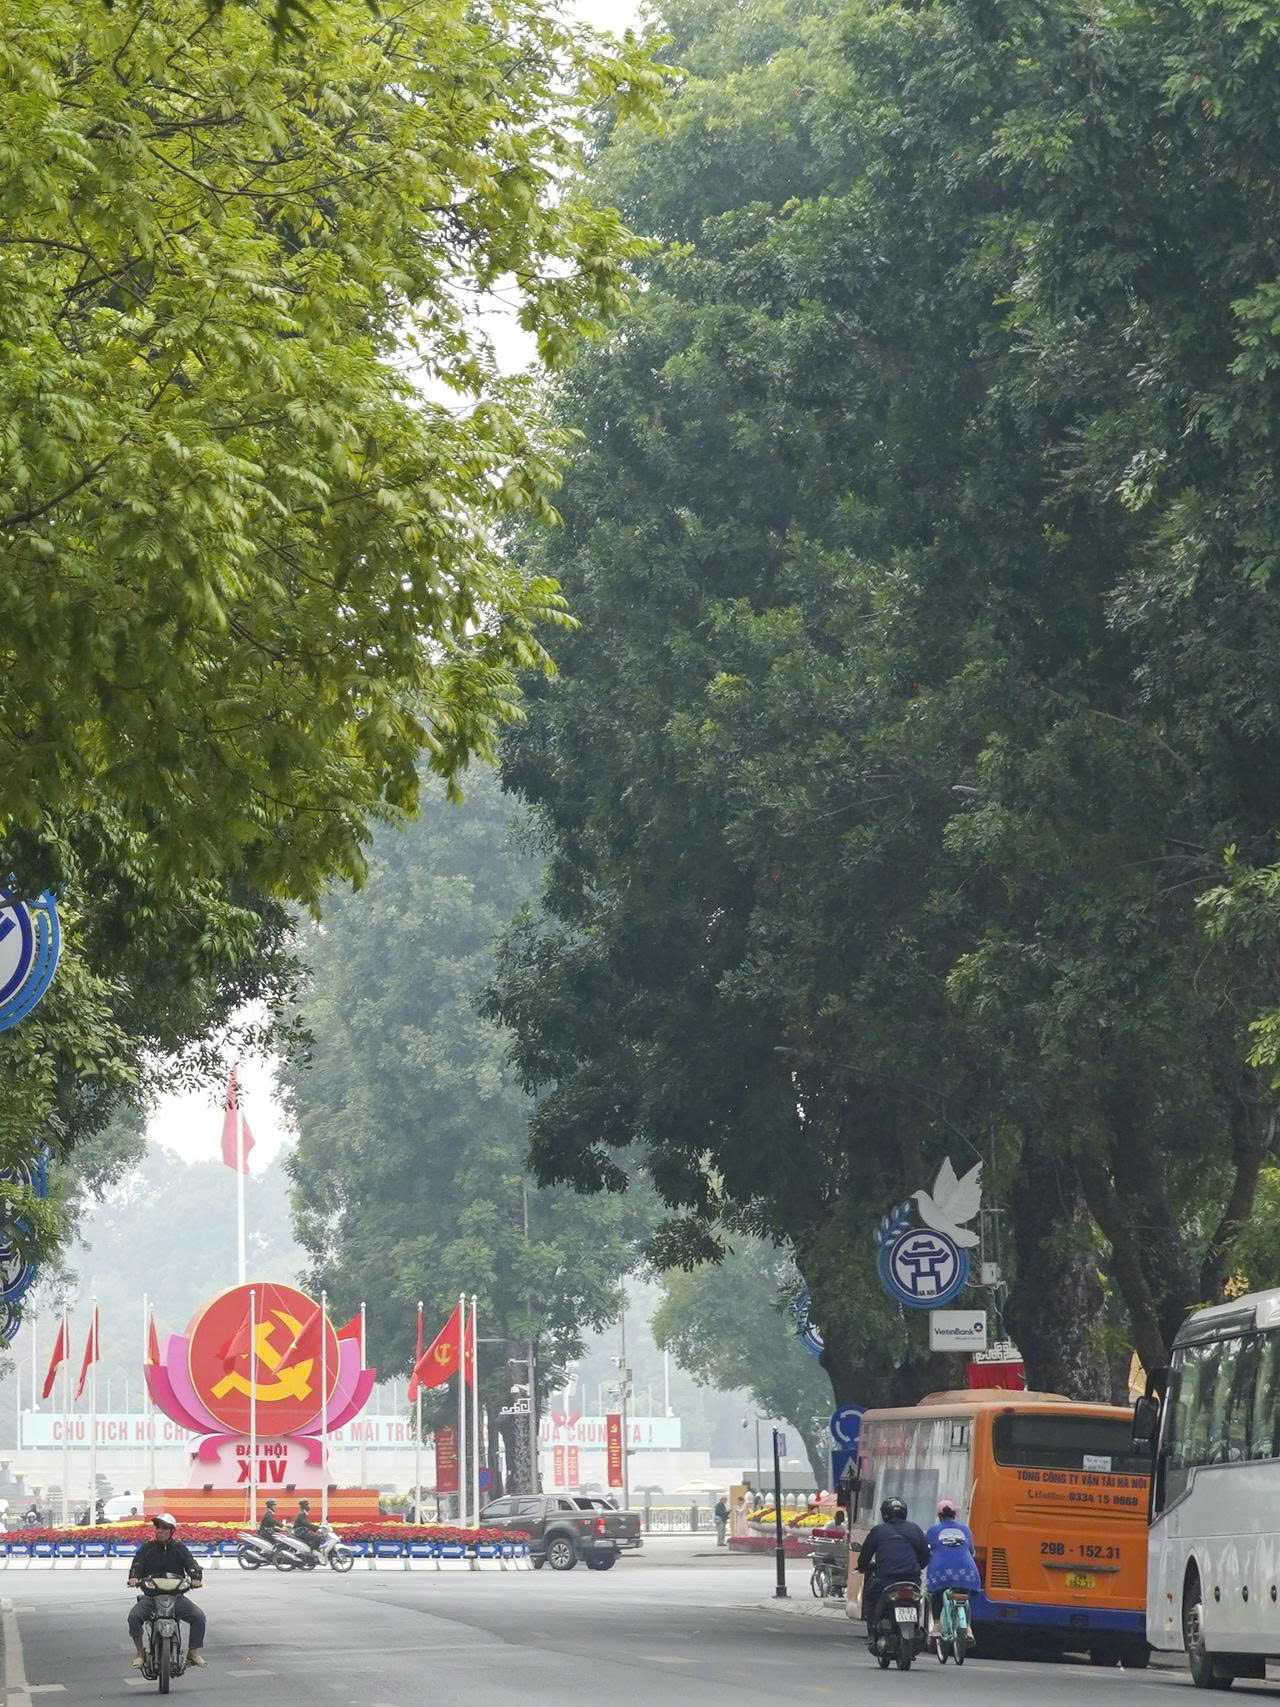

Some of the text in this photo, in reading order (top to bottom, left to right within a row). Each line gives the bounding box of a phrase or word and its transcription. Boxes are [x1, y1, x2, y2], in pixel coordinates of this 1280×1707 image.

[934, 1328, 974, 1336] VietinBank
[264, 1442, 288, 1458] HỘI
[237, 1460, 288, 1483] XIV
[1098, 1494, 1110, 1504] 15
[1040, 1542, 1065, 1555] 29B
[1079, 1544, 1121, 1559] 152.31
